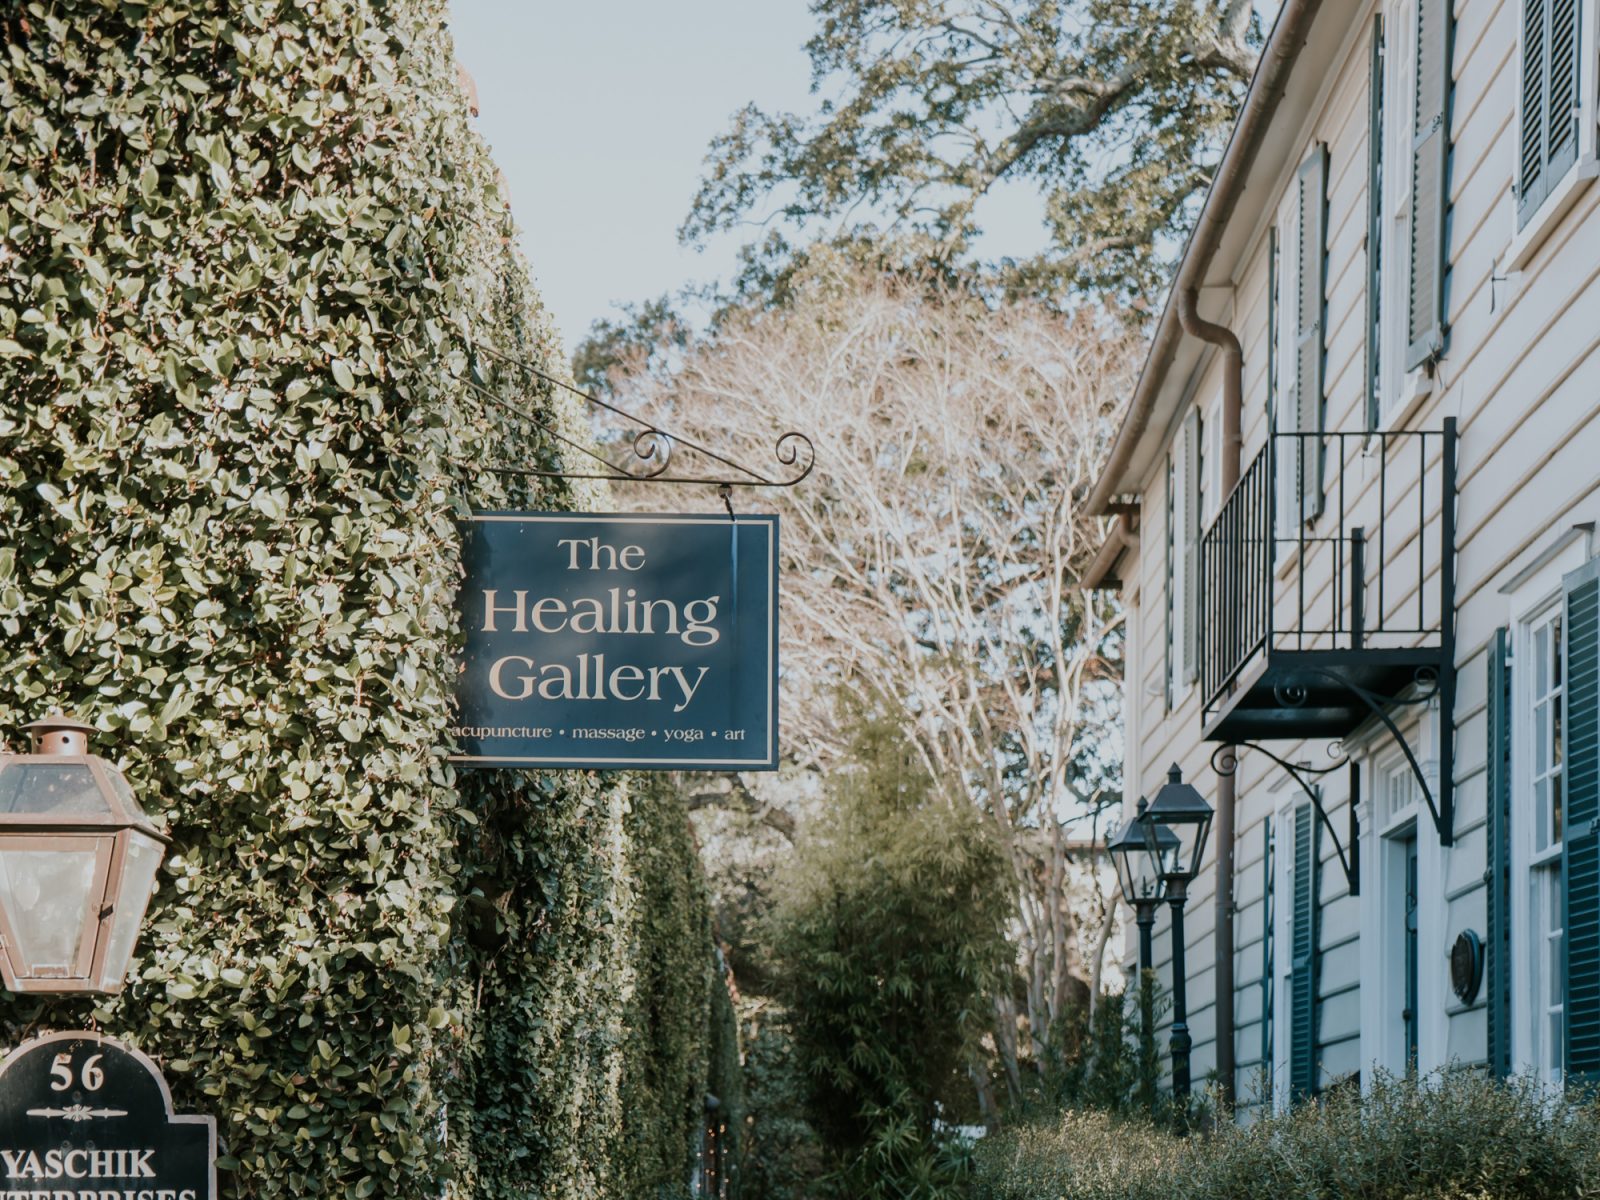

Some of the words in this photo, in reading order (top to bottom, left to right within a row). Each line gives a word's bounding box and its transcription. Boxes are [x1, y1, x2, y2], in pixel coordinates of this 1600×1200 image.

[557, 537, 646, 571] The
[480, 588, 720, 646] Healing
[488, 653, 710, 713] Gallery
[451, 726, 553, 740] acupuncture
[572, 727, 646, 744] massage
[664, 729, 704, 743] yoga
[724, 728, 747, 741] art
[50, 1053, 104, 1092] 56
[0, 1149, 157, 1178] YASCHIK
